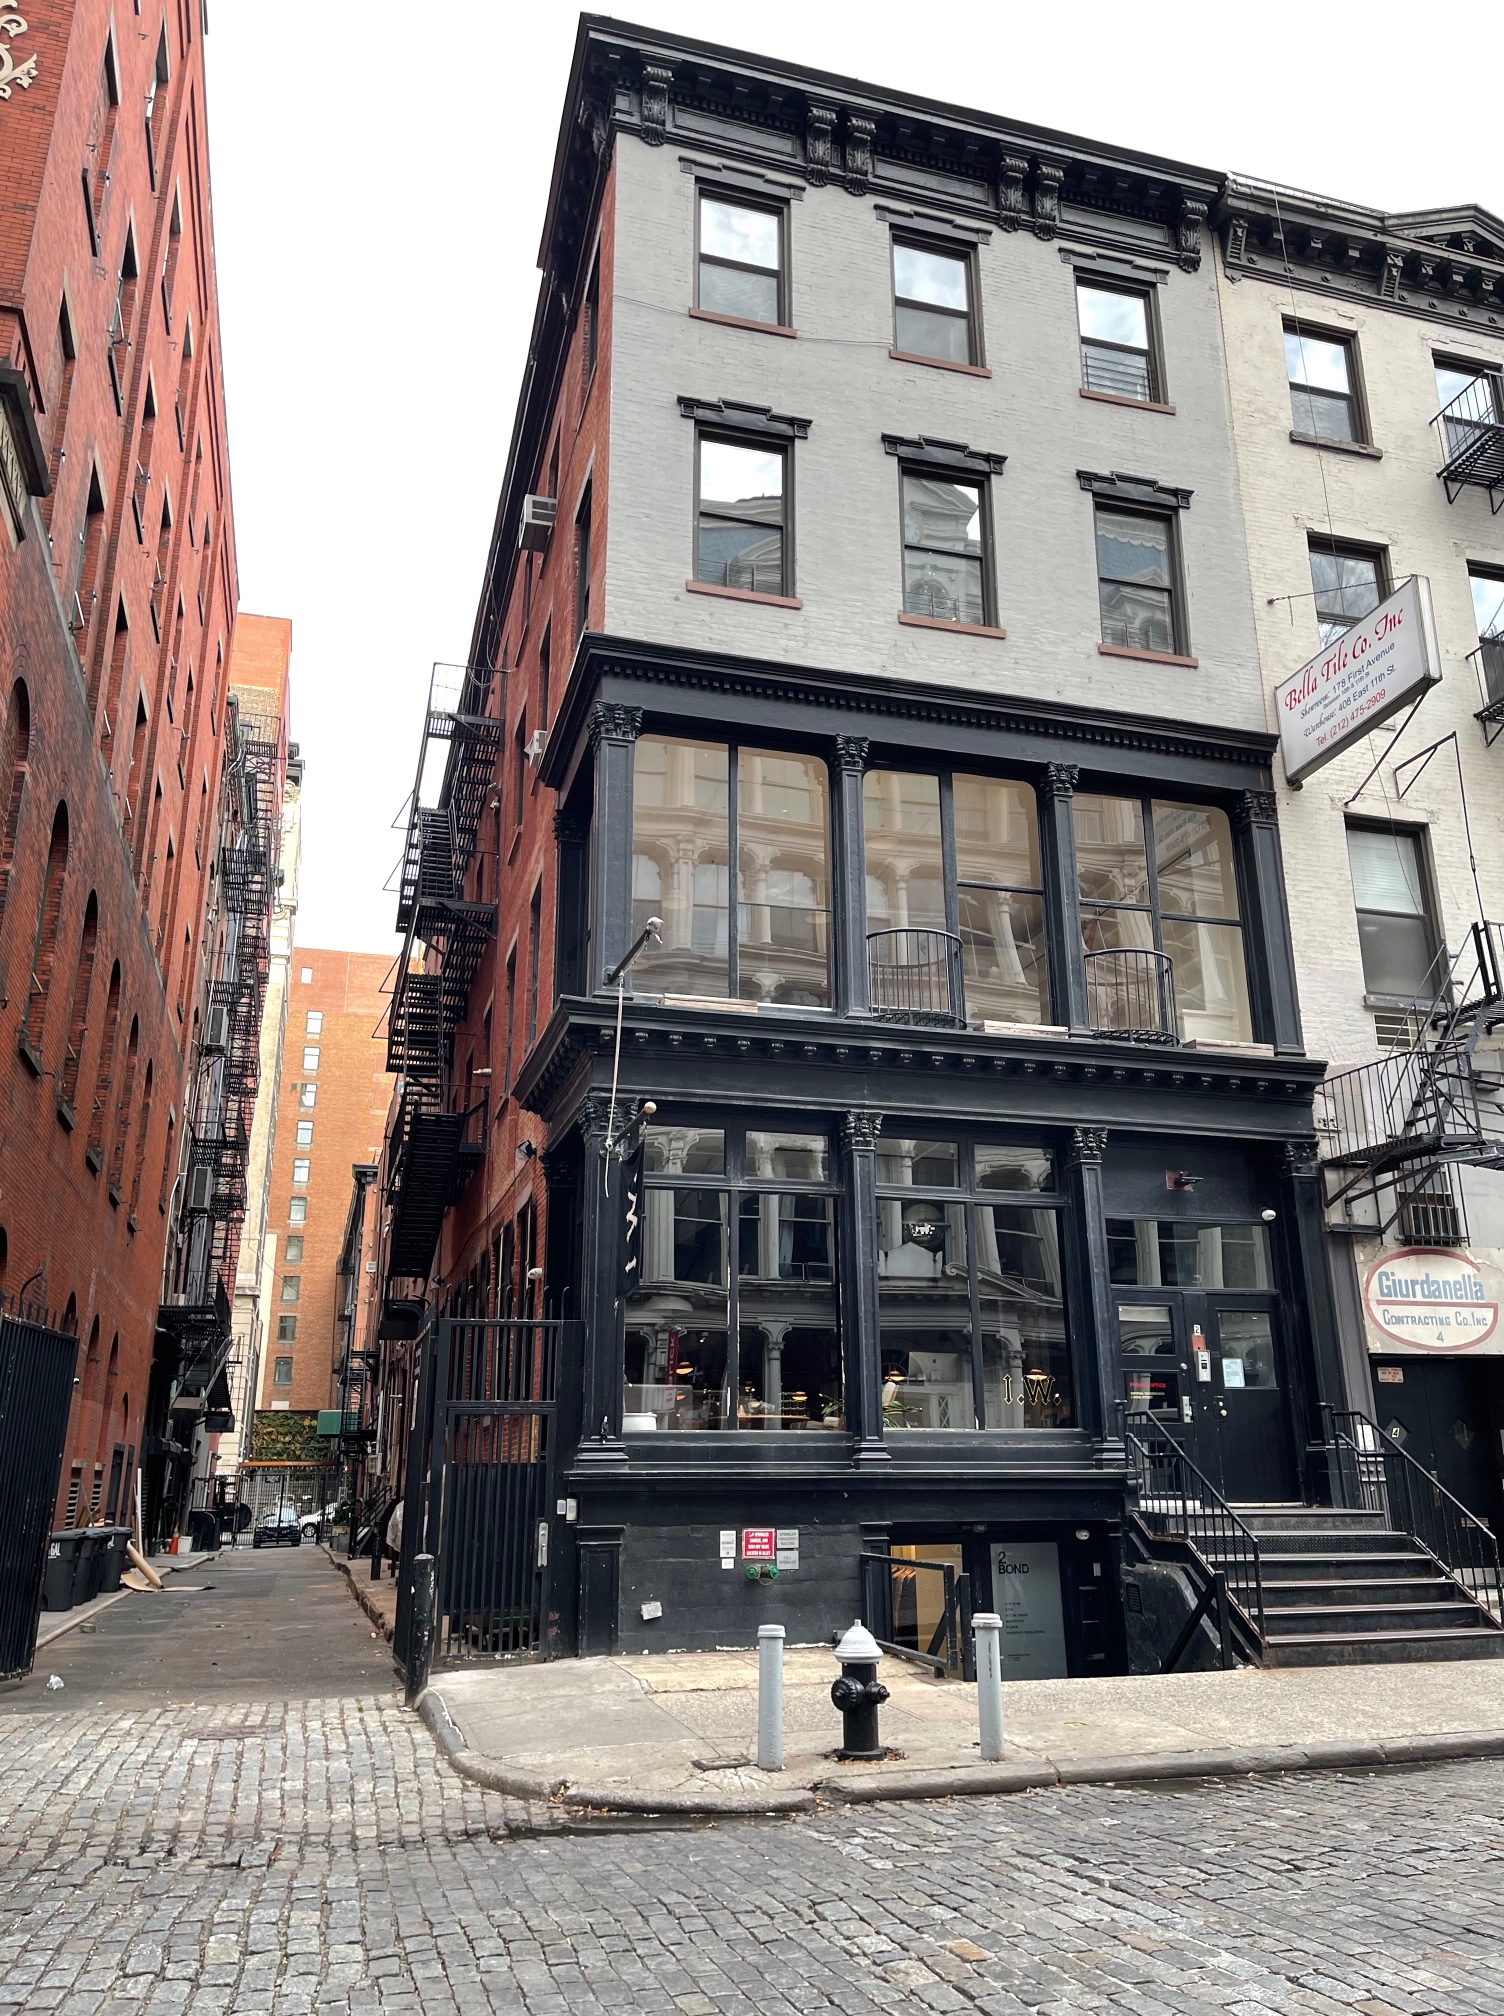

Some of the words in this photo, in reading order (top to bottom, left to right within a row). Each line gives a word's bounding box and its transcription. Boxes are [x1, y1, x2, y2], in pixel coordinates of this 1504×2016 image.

[1284, 665, 1319, 711] Bella
[1321, 640, 1348, 683] Tile
[1352, 635, 1372, 660] Co.
[1374, 608, 1404, 641] Inc
[1332, 679, 1346, 694] 178
[1347, 664, 1365, 683] First
[1366, 642, 1395, 670] Avenue
[1338, 697, 1352, 712] 408
[1352, 684, 1370, 702] East
[1370, 671, 1386, 688] 11th
[1386, 663, 1397, 676] St.
[1316, 731, 1329, 747] Tel.
[1330, 716, 1350, 739] (212)
[1350, 688, 1387, 721] 475-2909
[1377, 1270, 1485, 1301] Giurdanella
[1195, 1325, 1200, 1334] 2
[1436, 1331, 1445, 1343] 4
[1392, 1428, 1399, 1437] 4
[998, 1551, 1006, 1564] 2
[998, 1563, 1030, 1575] BOND
